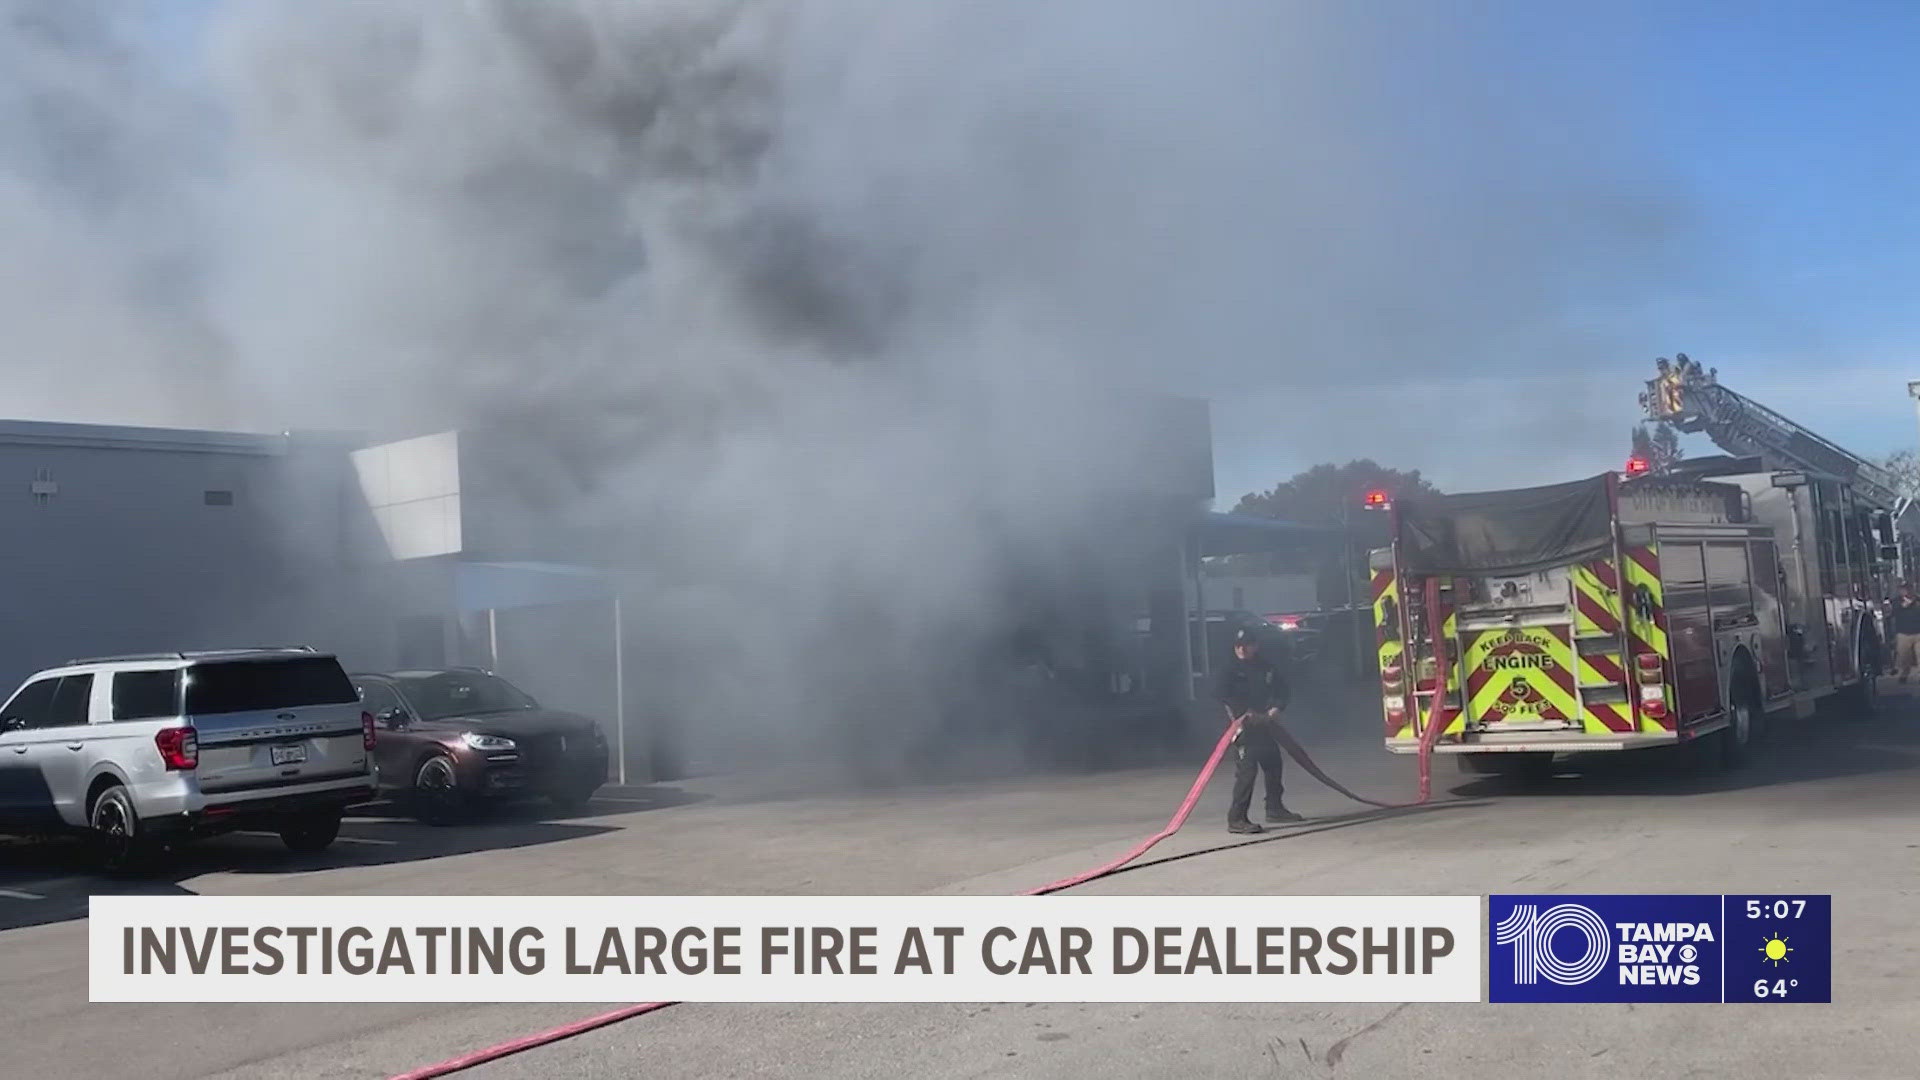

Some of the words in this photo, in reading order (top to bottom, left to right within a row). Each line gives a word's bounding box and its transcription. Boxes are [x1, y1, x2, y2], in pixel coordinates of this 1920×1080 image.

[1480, 633, 1514, 652] KEEP
[1515, 633, 1551, 649] BACK
[1482, 654, 1554, 671] ENGINE
[1511, 675, 1531, 699] 5
[1519, 698, 1552, 714] FEET
